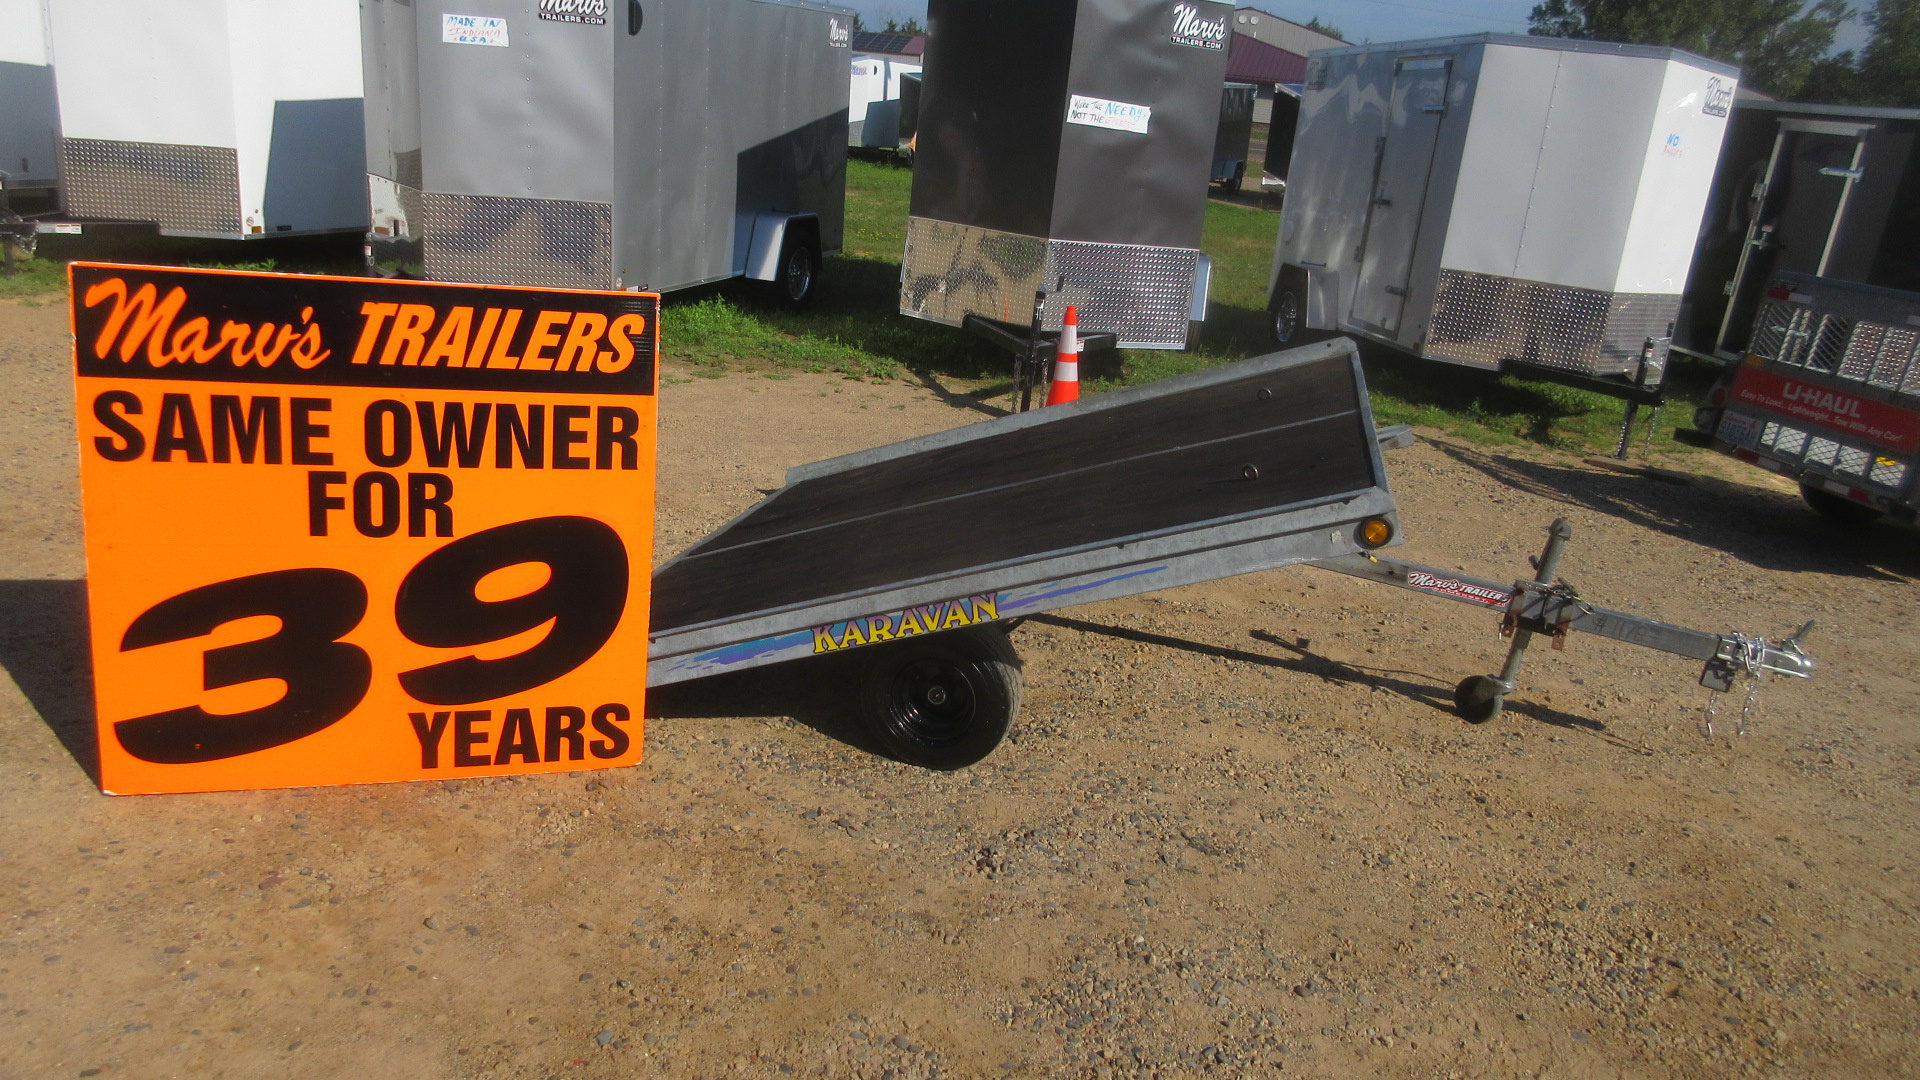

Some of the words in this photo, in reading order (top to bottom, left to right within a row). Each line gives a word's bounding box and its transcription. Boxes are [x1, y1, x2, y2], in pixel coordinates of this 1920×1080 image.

[447, 16, 477, 27] MADE
[484, 18, 501, 28] IN
[540, 0, 607, 16] arvs
[541, 12, 604, 25] TRAILERS.COM
[1173, 3, 1226, 41] Marv's
[1172, 36, 1221, 49] TRAILERS.COM
[85, 277, 330, 370] Marv's
[352, 301, 645, 374] TRAILERS
[1782, 382, 1862, 418] U-HAUL
[92, 389, 335, 466] SAME
[363, 398, 640, 471] OWNER
[307, 470, 455, 538] FOR
[1409, 572, 1459, 590] Marv's
[113, 515, 630, 765] 39
[810, 592, 1001, 655] KARAVAN
[408, 703, 631, 769] YEARS
